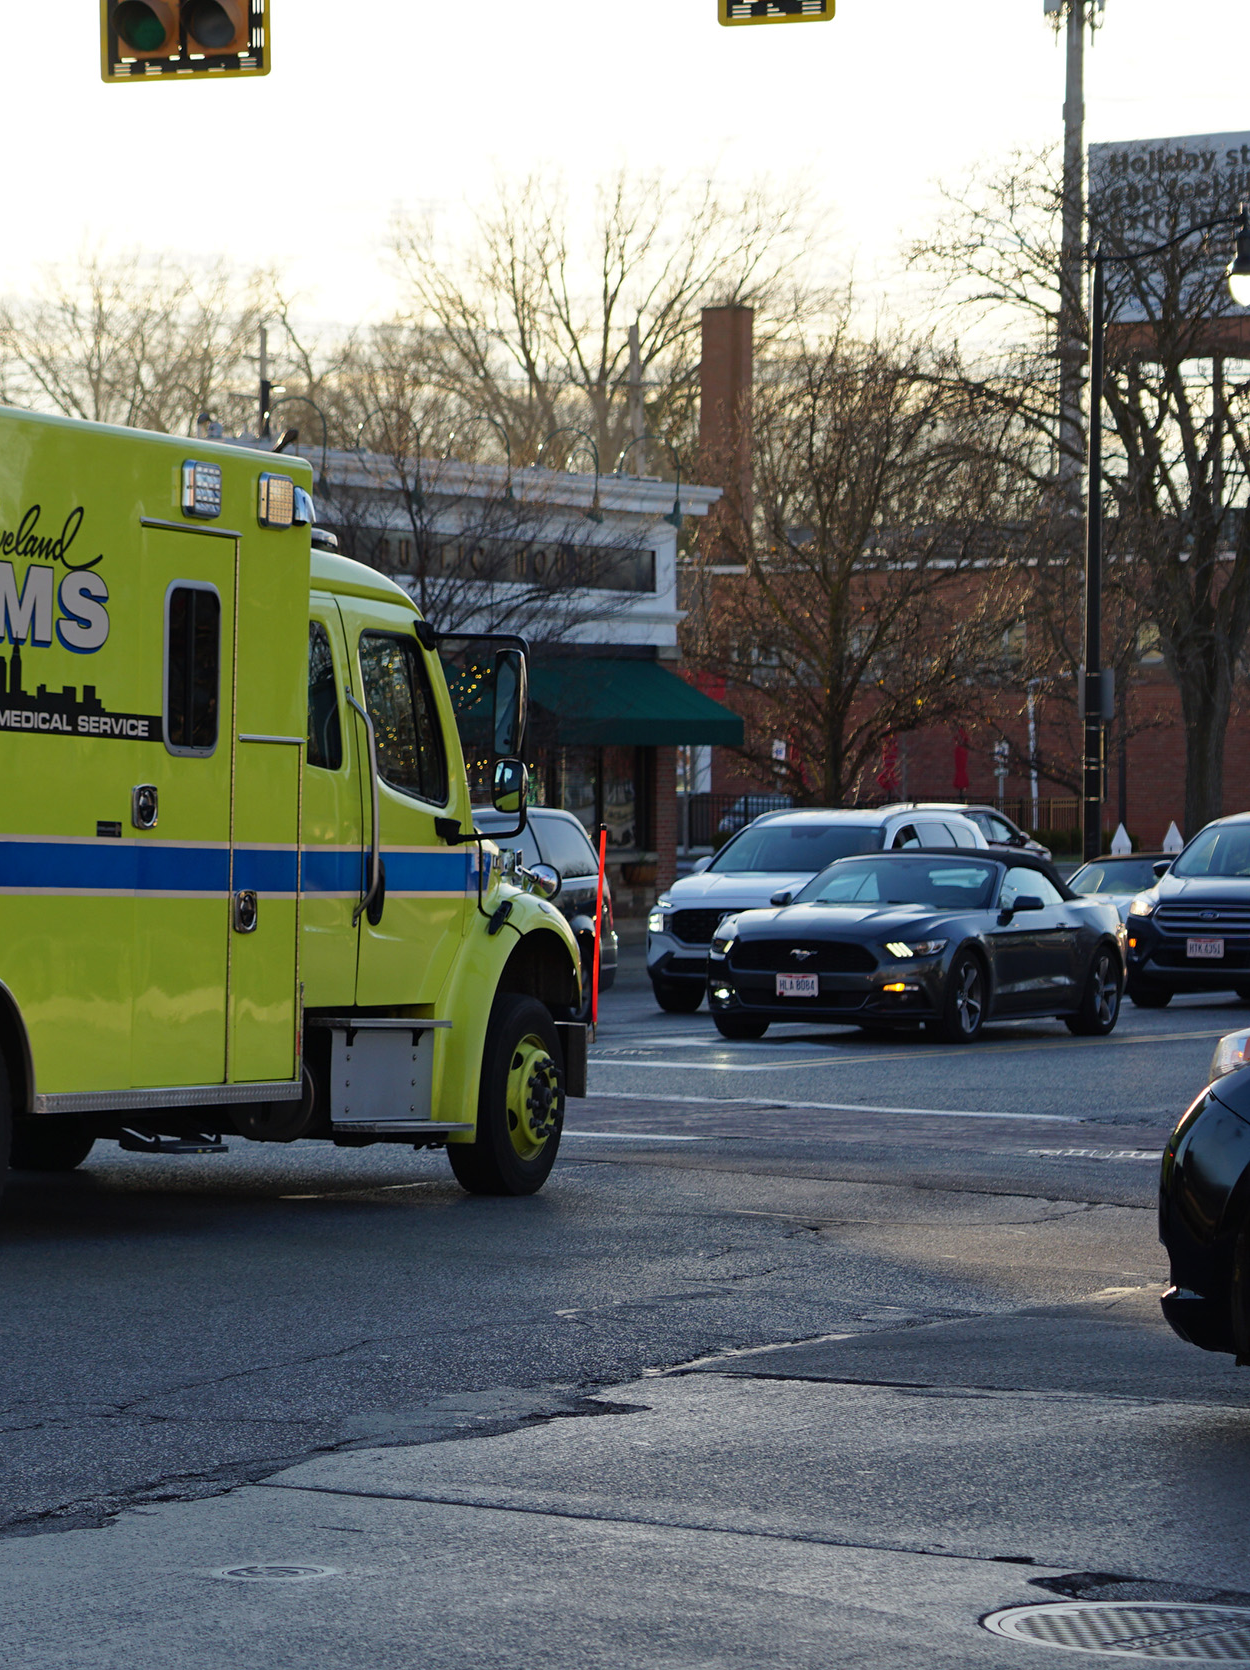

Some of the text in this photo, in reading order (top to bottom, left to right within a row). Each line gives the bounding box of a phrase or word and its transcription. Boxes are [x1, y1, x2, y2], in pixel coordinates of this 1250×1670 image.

[1109, 148, 1217, 174] Holiday
[378, 539, 486, 572] PULIC
[77, 715, 149, 737] SERVICE
